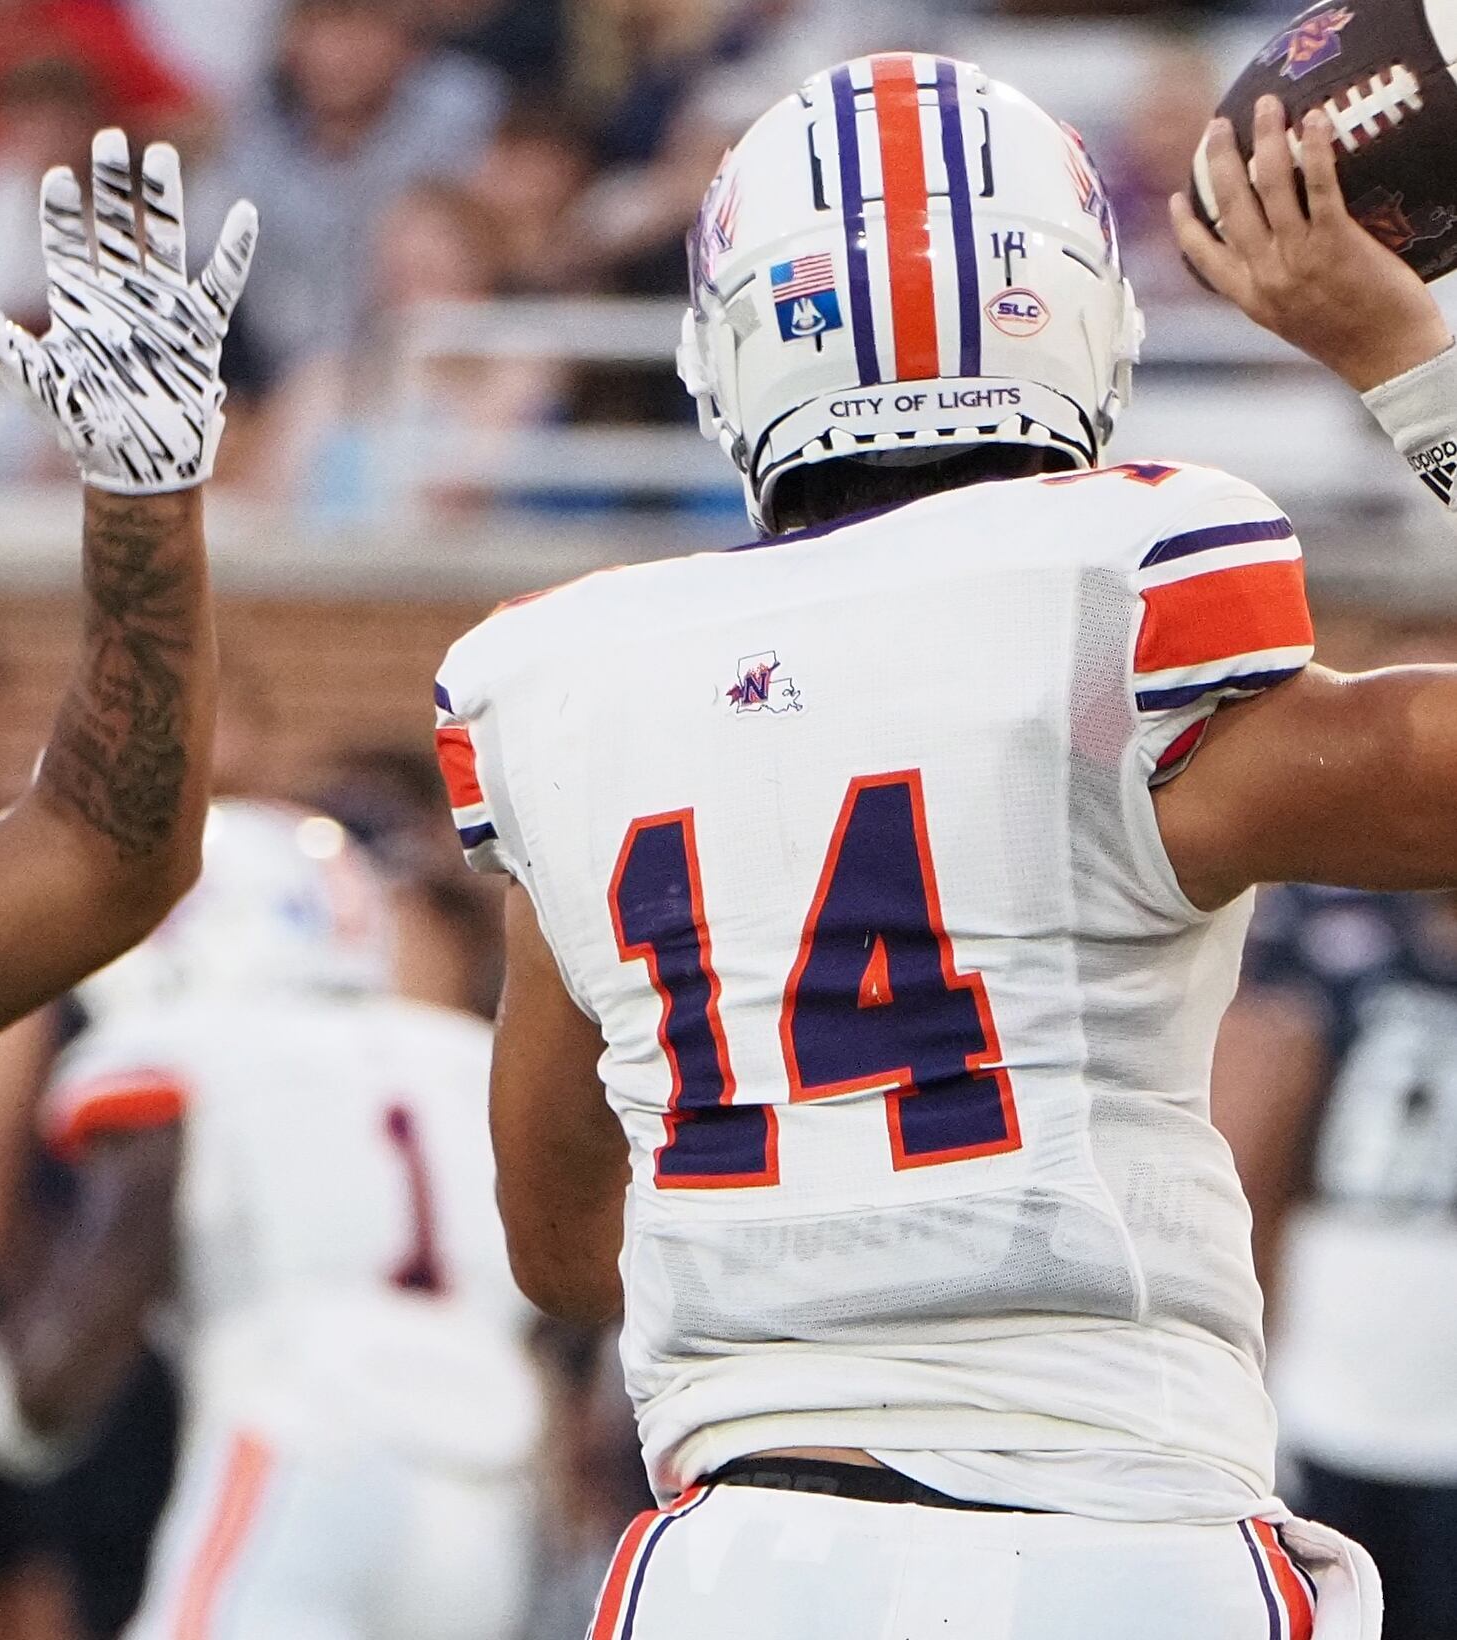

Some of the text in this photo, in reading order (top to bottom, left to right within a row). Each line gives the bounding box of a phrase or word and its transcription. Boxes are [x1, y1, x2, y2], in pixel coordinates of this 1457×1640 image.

[997, 302, 1040, 318] SLC
[829, 387, 1022, 418] CITY OF LIGHTS
[607, 768, 1023, 1190] 14
